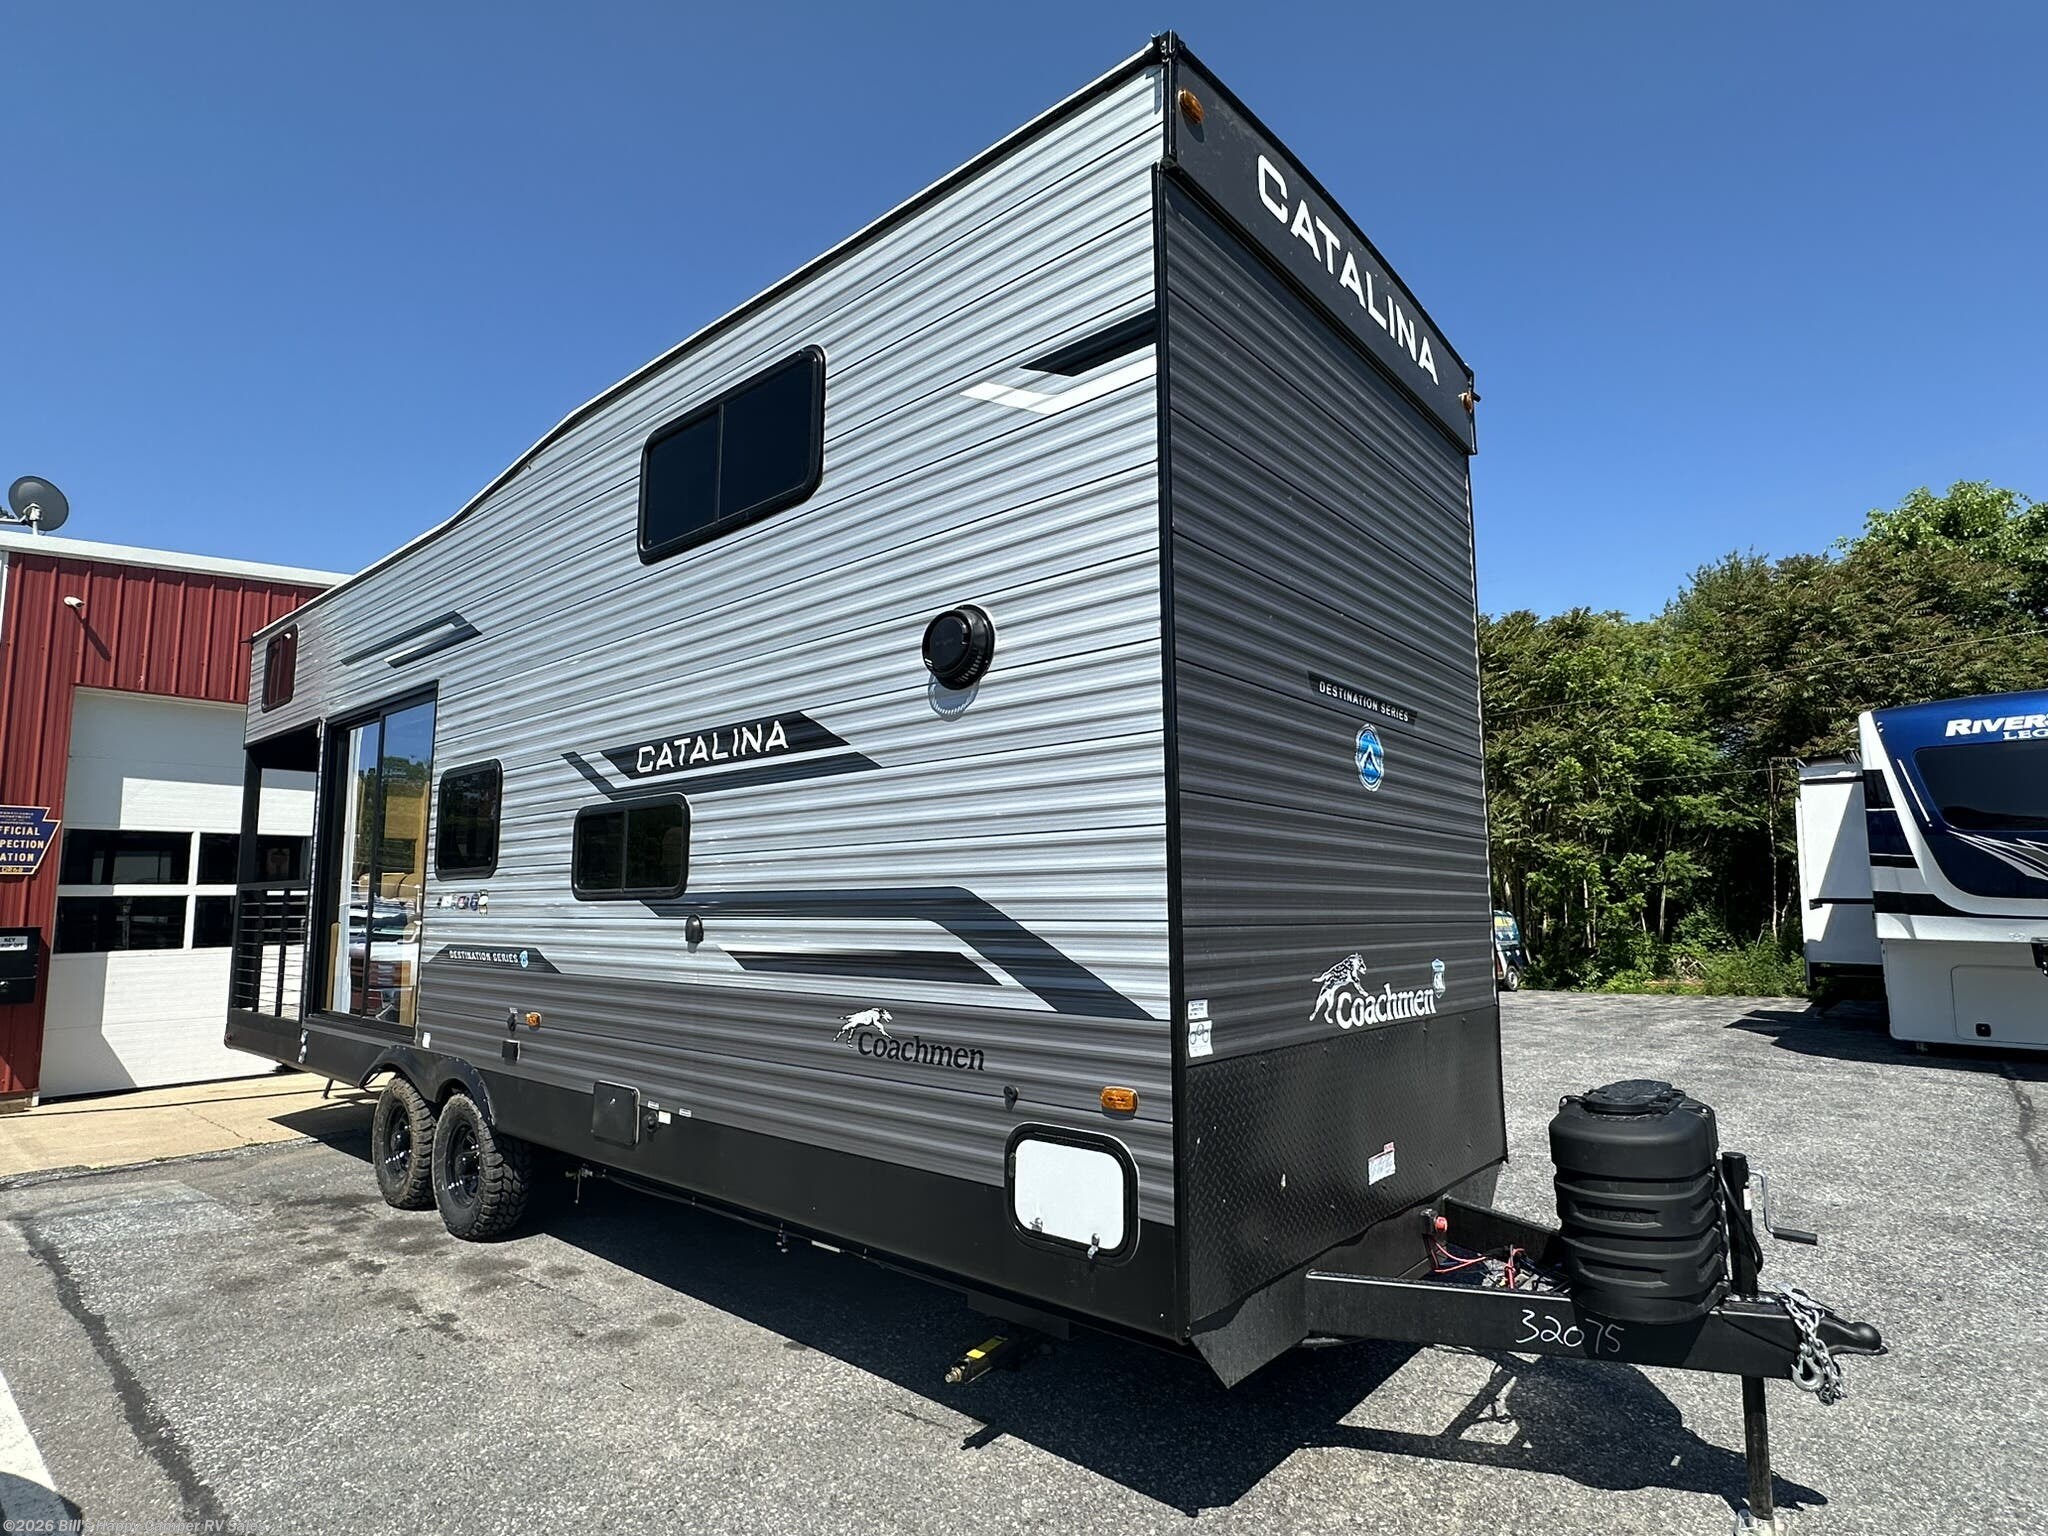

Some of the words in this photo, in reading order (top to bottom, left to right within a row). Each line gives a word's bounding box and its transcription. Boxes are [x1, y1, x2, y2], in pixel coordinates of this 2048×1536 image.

[1257, 154, 1439, 386] CATALINA
[1319, 681, 1378, 712] DESTINATION
[1380, 702, 1409, 722] SERIES
[636, 719, 789, 774] CATALINA
[1945, 713, 2048, 737] RIVER
[448, 950, 492, 961] DESTINATION
[492, 952, 518, 963] SERIES
[1336, 983, 1436, 1029] Coachmen
[857, 1031, 985, 1072] Coachmen
[1515, 1309, 1625, 1354] 32075
